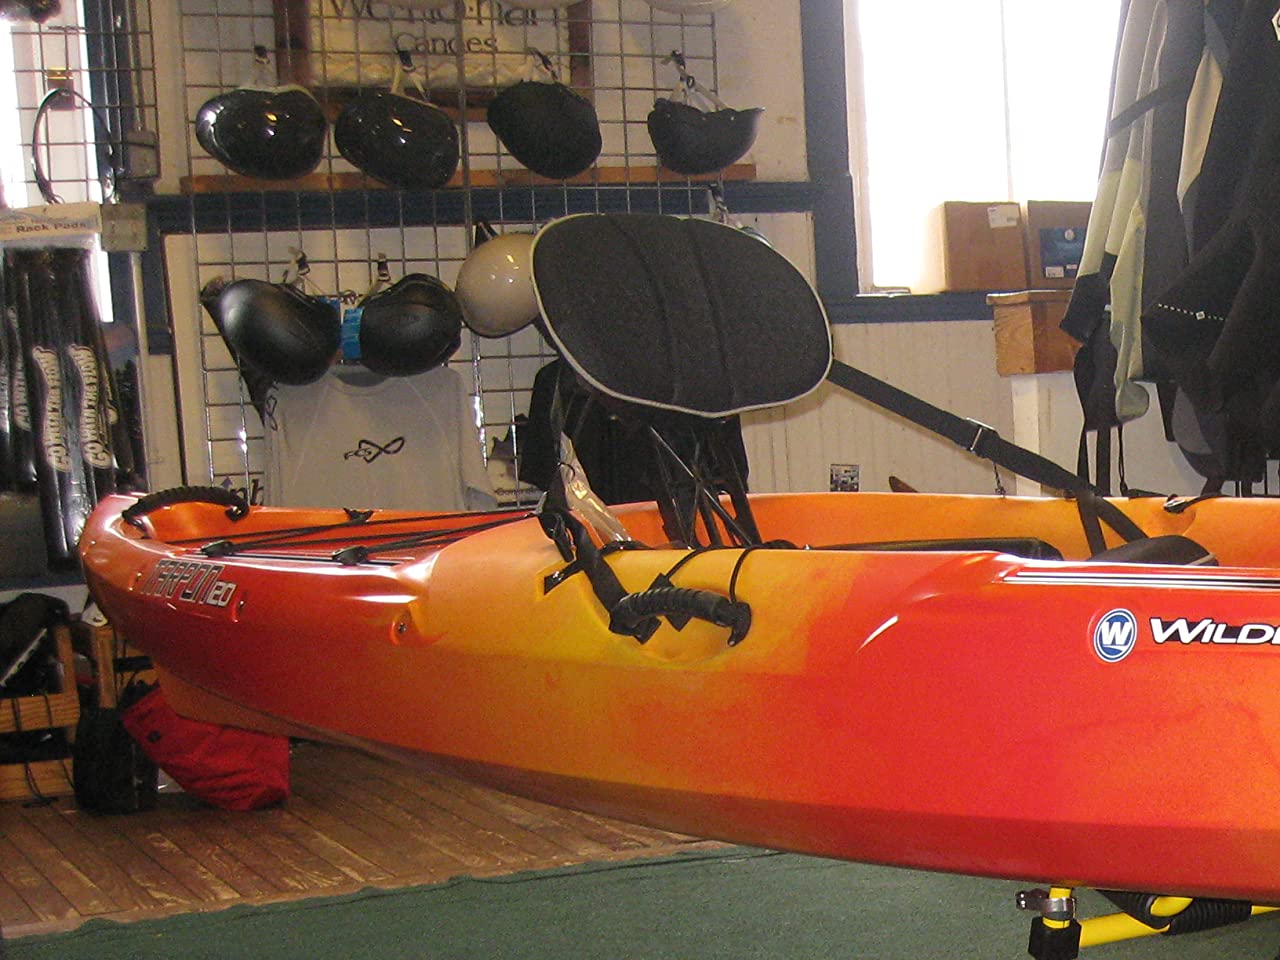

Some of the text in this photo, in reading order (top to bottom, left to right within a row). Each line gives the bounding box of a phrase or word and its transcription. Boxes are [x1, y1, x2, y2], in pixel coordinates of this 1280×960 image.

[396, 31, 498, 54] Canoes
[16, 222, 87, 233] Rack Pads
[71, 347, 110, 466] GO WITH THE FLOW
[47, 445, 70, 468] GO
[140, 559, 226, 604] TARPON
